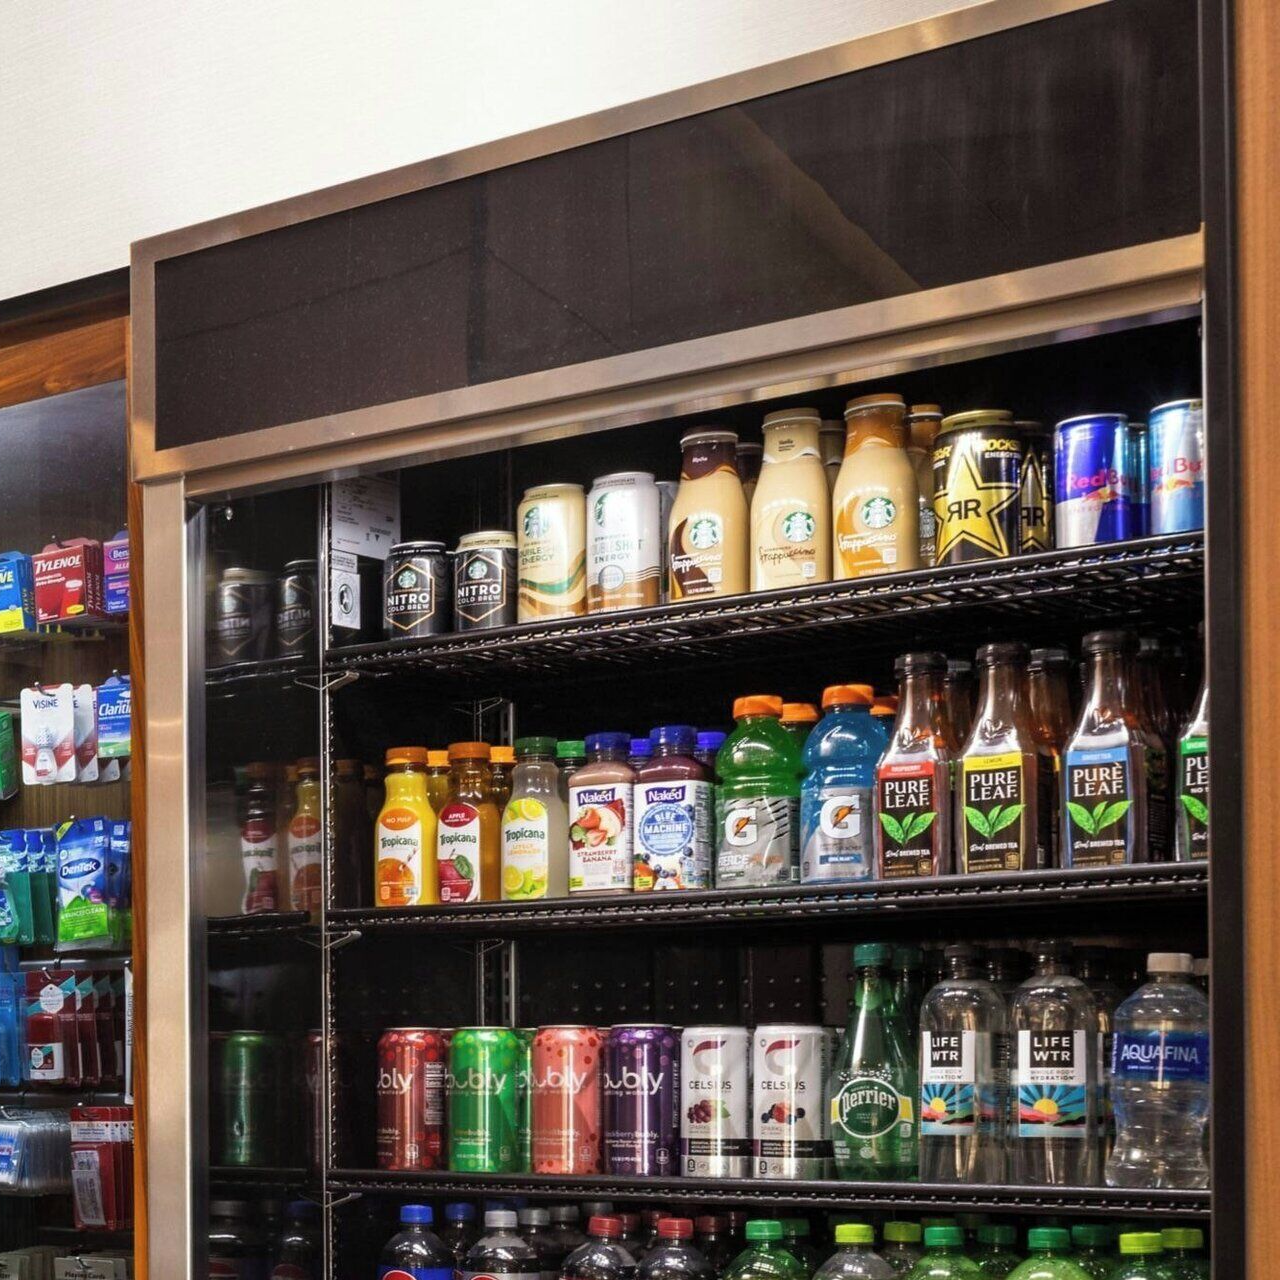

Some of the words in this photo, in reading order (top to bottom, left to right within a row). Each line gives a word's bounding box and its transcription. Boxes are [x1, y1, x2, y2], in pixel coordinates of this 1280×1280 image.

[34, 553, 82, 576] TYLENOL
[457, 584, 501, 598] NITRO
[386, 593, 430, 607] NITRO
[457, 597, 477, 606] COLD
[478, 594, 502, 604] BREW
[386, 604, 407, 614] COLD
[408, 603, 430, 613] BREW
[33, 697, 59, 710] VISINE
[969, 770, 1019, 789] PURE
[1073, 764, 1124, 783] PURE
[884, 778, 930, 796] PURE
[578, 789, 614, 804] Naked
[647, 788, 684, 804] Naked
[655, 810, 676, 823] BLUE
[820, 794, 861, 839] G
[643, 822, 689, 834] MACHINE
[724, 807, 758, 847] G
[439, 832, 478, 845] Tropicana
[505, 827, 546, 843] Tropicana
[381, 835, 419, 849] Tropicana
[576, 849, 617, 859] STRAWBERRY
[582, 855, 613, 863] BANANA
[61, 860, 98, 877] DenTek
[931, 1036, 959, 1049] LIFE
[1033, 1036, 1071, 1048] LIFE
[931, 1050, 959, 1062] WTR
[1033, 1050, 1071, 1062] WTR
[1120, 1043, 1199, 1062] AQUAFINA
[688, 1080, 733, 1091] CELSIUS
[760, 1080, 806, 1091] CELSIUS
[64, 1271, 85, 1280] Playing
[86, 1271, 106, 1280] Cards
